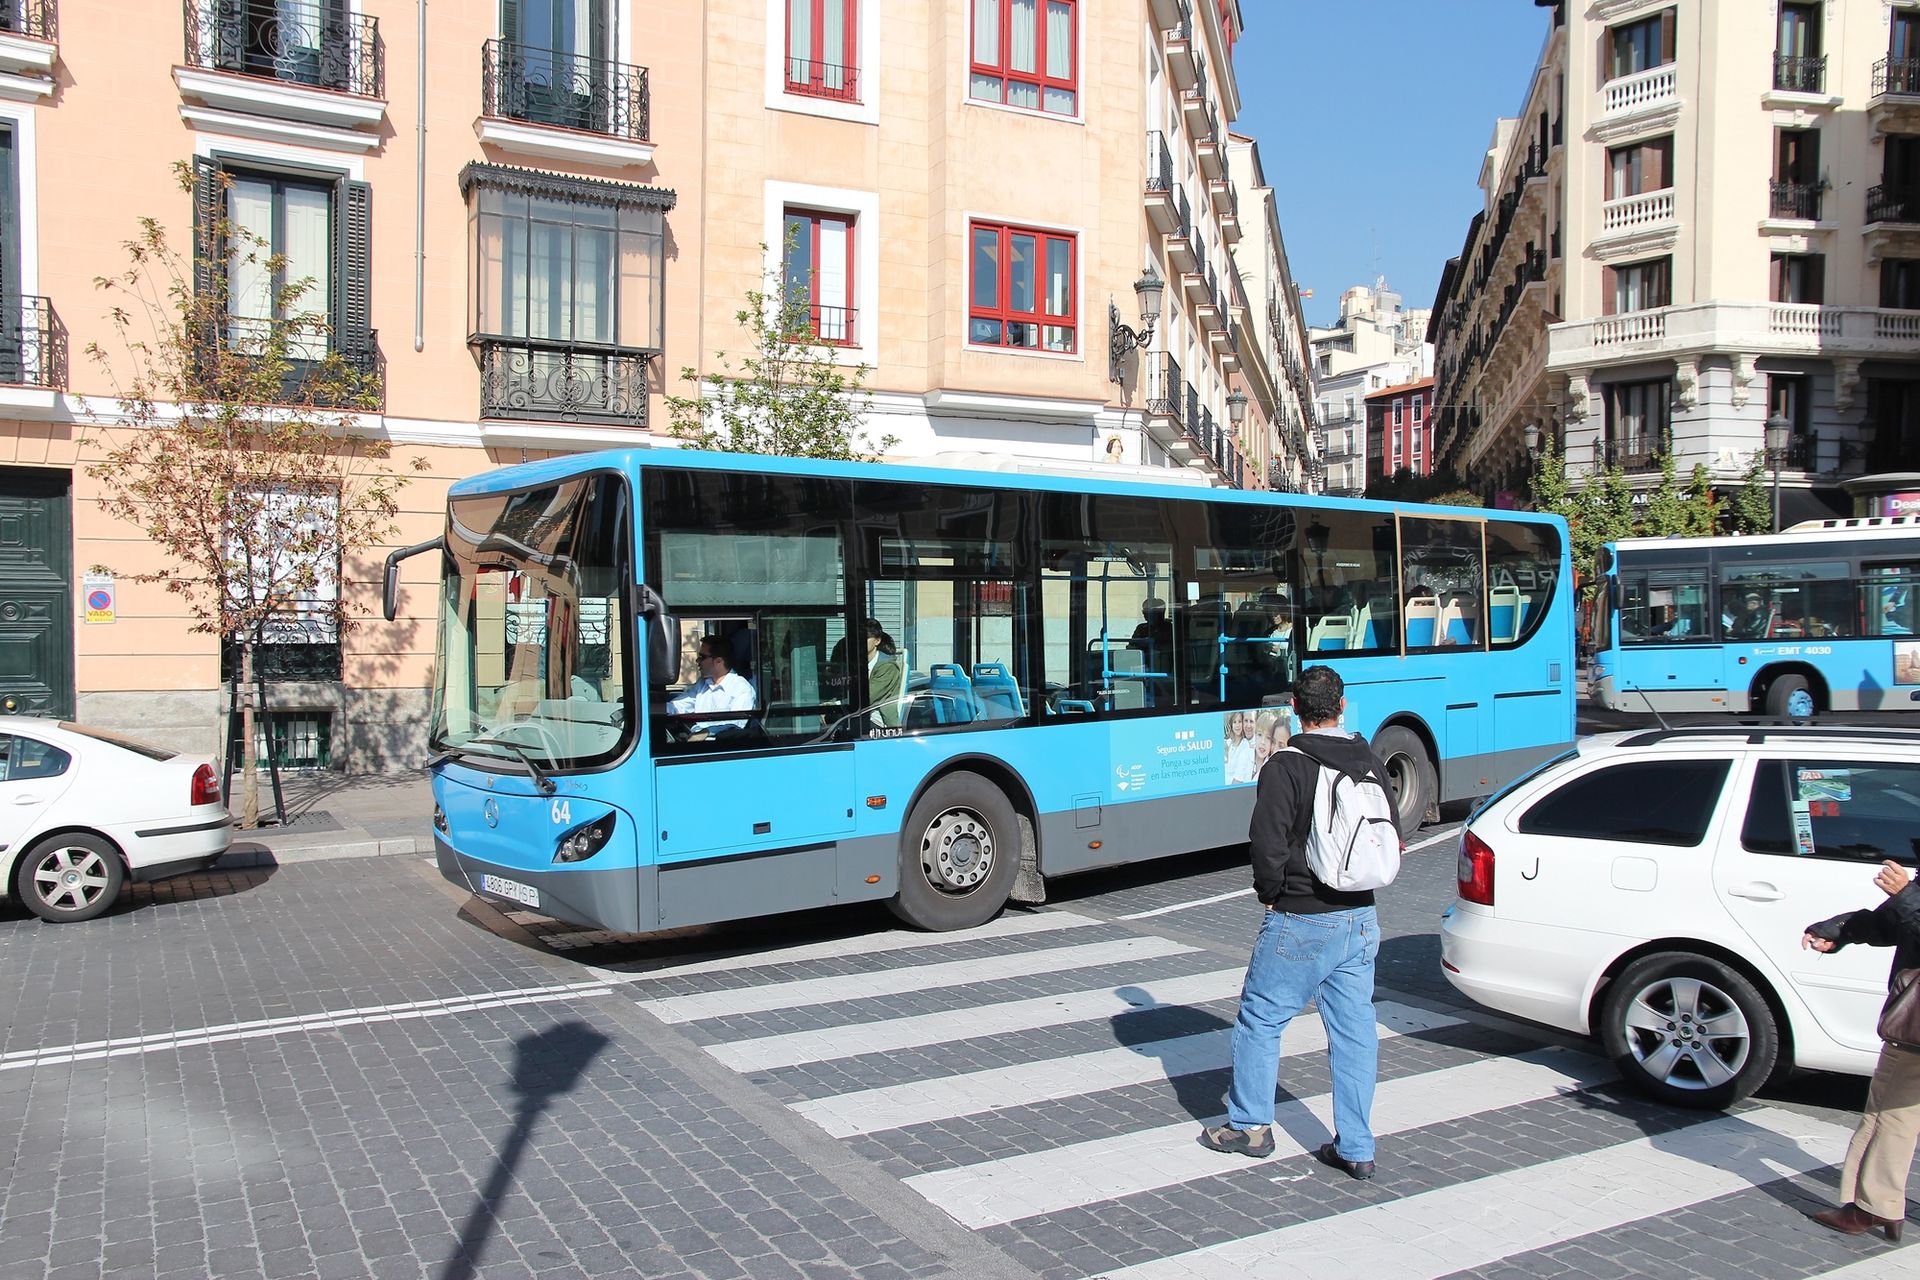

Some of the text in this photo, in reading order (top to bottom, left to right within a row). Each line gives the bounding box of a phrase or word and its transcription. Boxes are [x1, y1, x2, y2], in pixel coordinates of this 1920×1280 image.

[1778, 646, 1801, 655] EMT
[1804, 646, 1832, 655] 4030
[1156, 739, 1213, 756] Seguro de SALUD
[1161, 759, 1182, 769] Ponga
[1191, 755, 1209, 765] salud
[1150, 766, 1219, 781] en las mejores manos
[551, 799, 571, 825] 64
